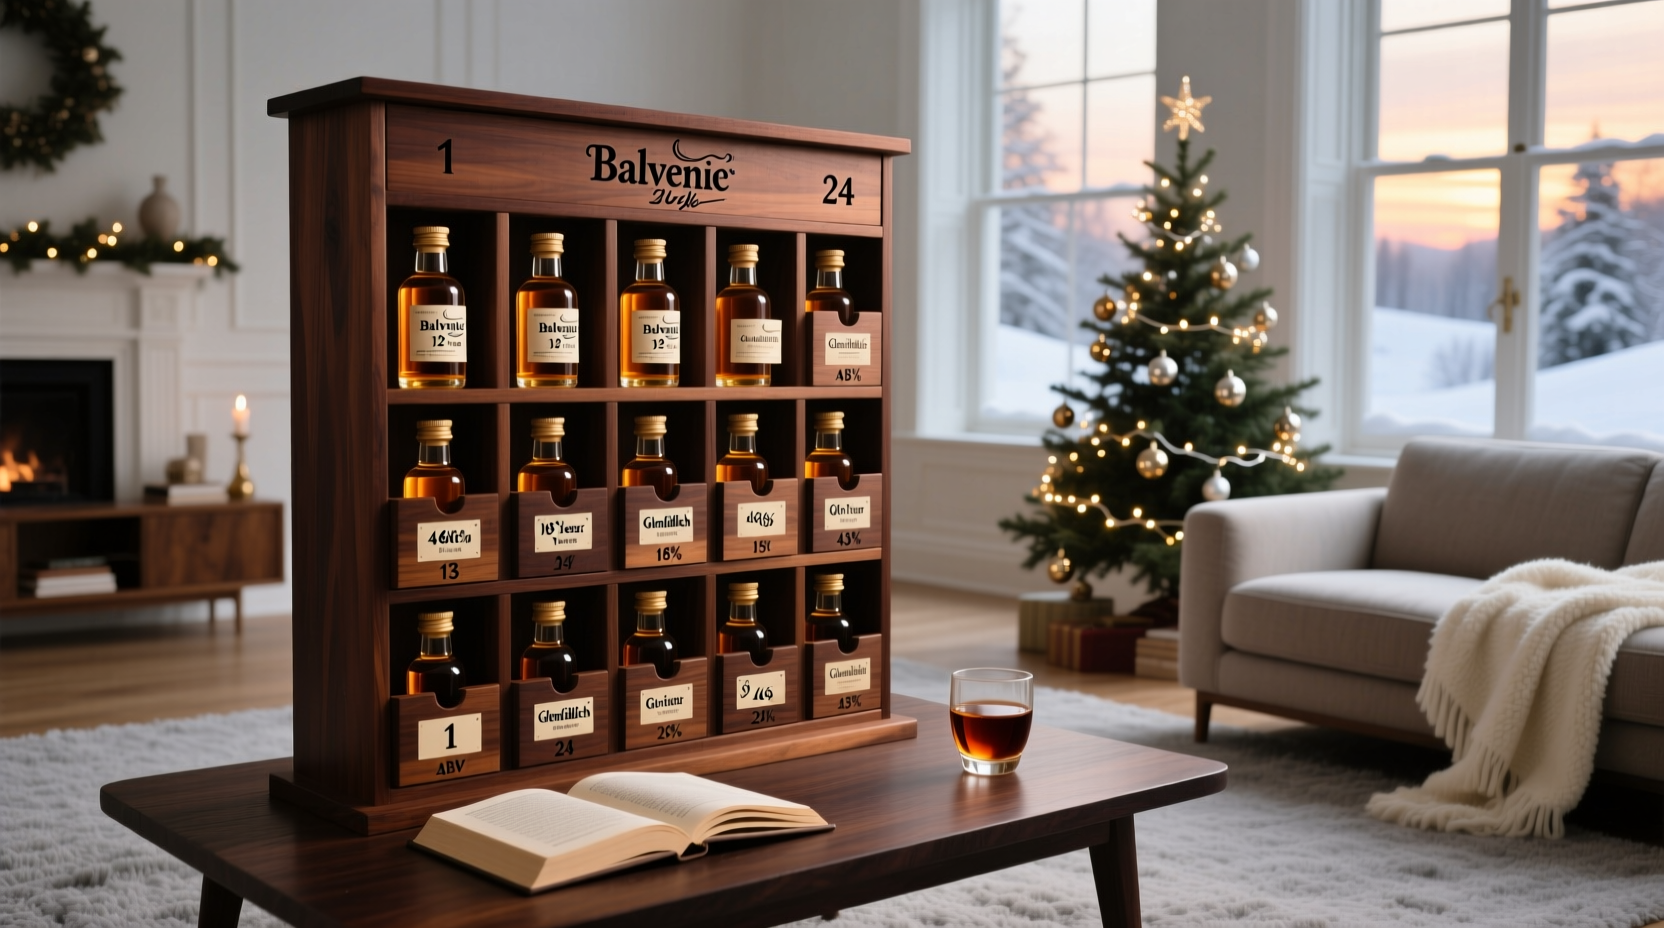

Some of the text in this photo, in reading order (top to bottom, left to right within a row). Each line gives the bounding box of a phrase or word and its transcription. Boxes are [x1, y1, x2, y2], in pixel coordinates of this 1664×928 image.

[437, 138, 454, 175] 1
[586, 143, 732, 192] Balvenie
[822, 173, 855, 206] 24
[439, 562, 460, 580] 13
[444, 722, 457, 750] 1
[554, 739, 574, 757] 24
[436, 759, 465, 776] ABV
